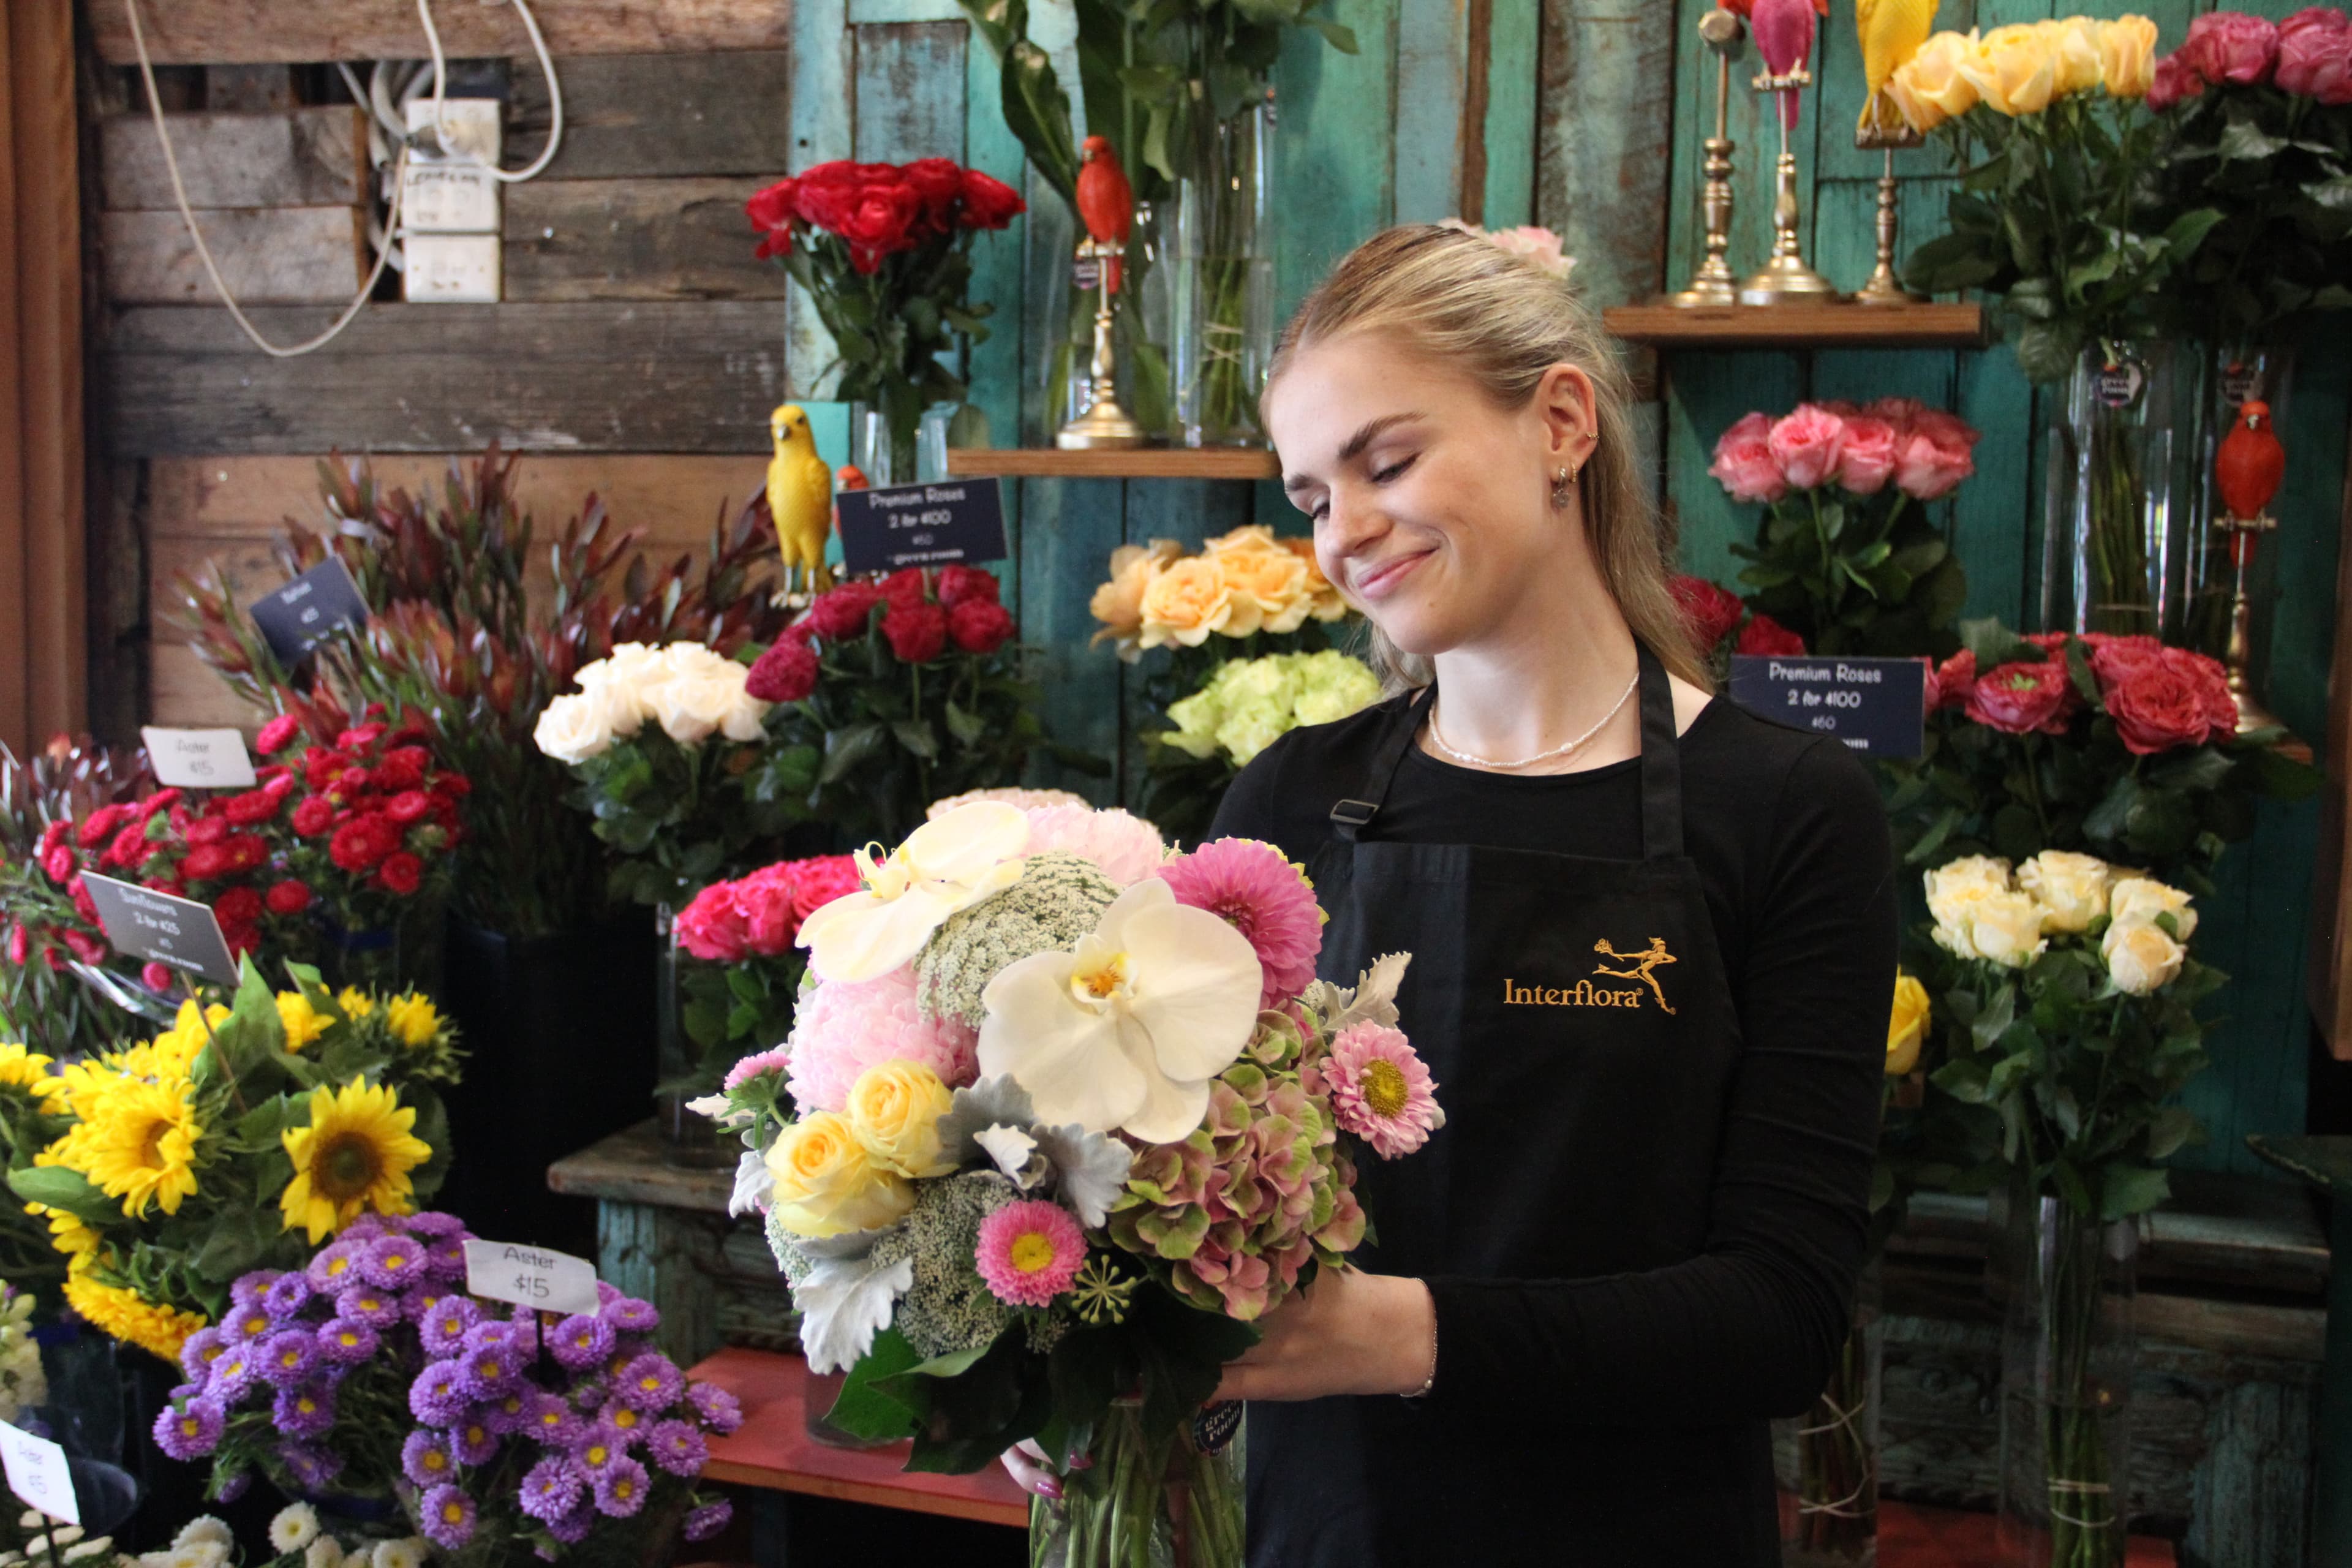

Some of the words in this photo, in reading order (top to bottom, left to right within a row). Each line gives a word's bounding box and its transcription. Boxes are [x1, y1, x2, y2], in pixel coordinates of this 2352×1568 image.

[869, 492, 922, 509] Premium
[925, 487, 965, 503] Roses
[888, 514, 898, 529] 2
[1769, 662, 1830, 682] Premium
[1836, 663, 1882, 683] Roses
[1787, 688, 1798, 705] 2
[1803, 690, 1821, 707] for
[1825, 691, 1861, 708] $100
[1504, 979, 1640, 1008] Interflora
[504, 1246, 556, 1269] Aster
[514, 1273, 549, 1298] $15
